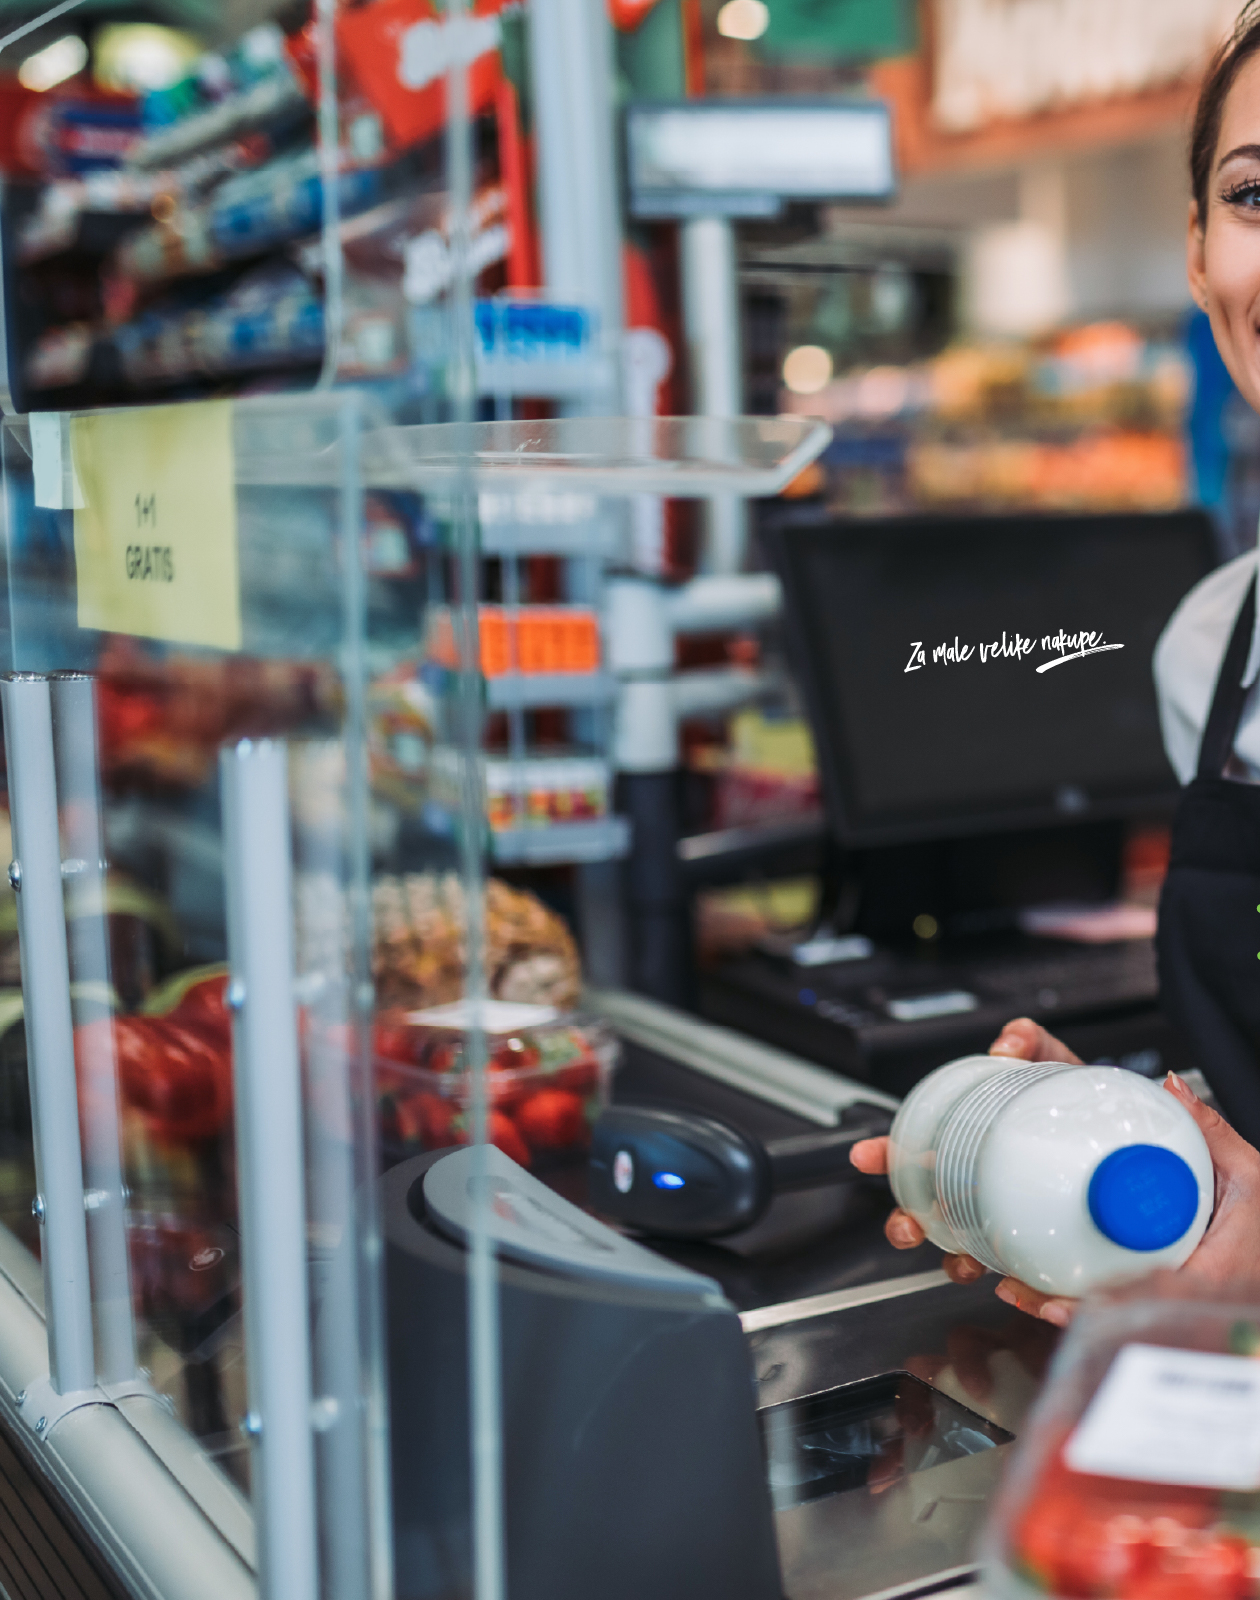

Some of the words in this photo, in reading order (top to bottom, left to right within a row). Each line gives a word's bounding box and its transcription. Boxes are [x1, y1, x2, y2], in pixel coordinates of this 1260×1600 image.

[135, 493, 156, 528] 1+1
[126, 545, 173, 583] GRATIS
[904, 641, 927, 673] Za
[932, 636, 975, 666] male
[979, 631, 1037, 663] velike
[1041, 628, 1107, 657] nakupe.
